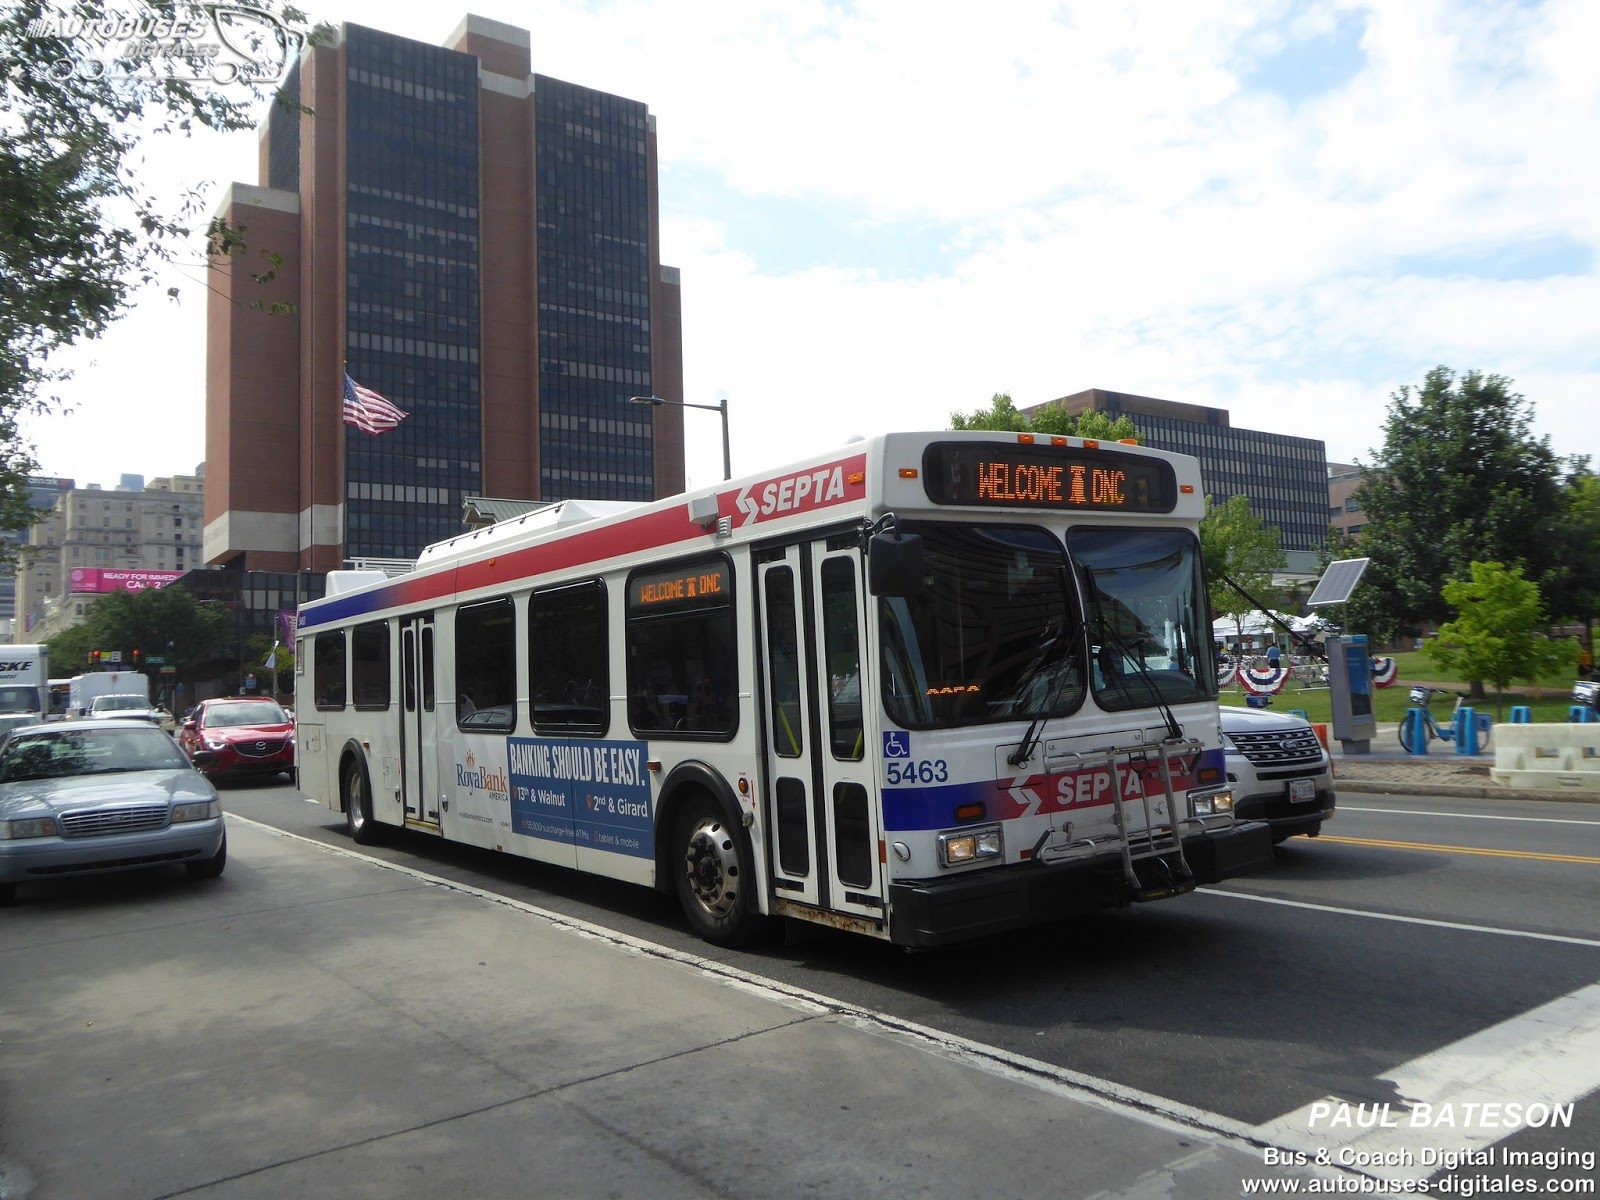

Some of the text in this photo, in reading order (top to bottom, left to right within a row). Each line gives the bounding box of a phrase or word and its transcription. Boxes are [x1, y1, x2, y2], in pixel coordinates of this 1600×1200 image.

[761, 466, 844, 515] SEPTA
[978, 462, 1125, 504] WELCOME DNC
[103, 572, 129, 580] READY
[641, 573, 721, 603] WELCOME DNC
[510, 743, 646, 786] BANKING SHOULD BE EASY.
[887, 759, 948, 785] 5463
[489, 791, 509, 802] AMERICA
[530, 789, 536, 803] &
[538, 789, 566, 807] Walnut
[1057, 768, 1142, 805] SEPTA
[593, 795, 648, 818] 2nd & Girard
